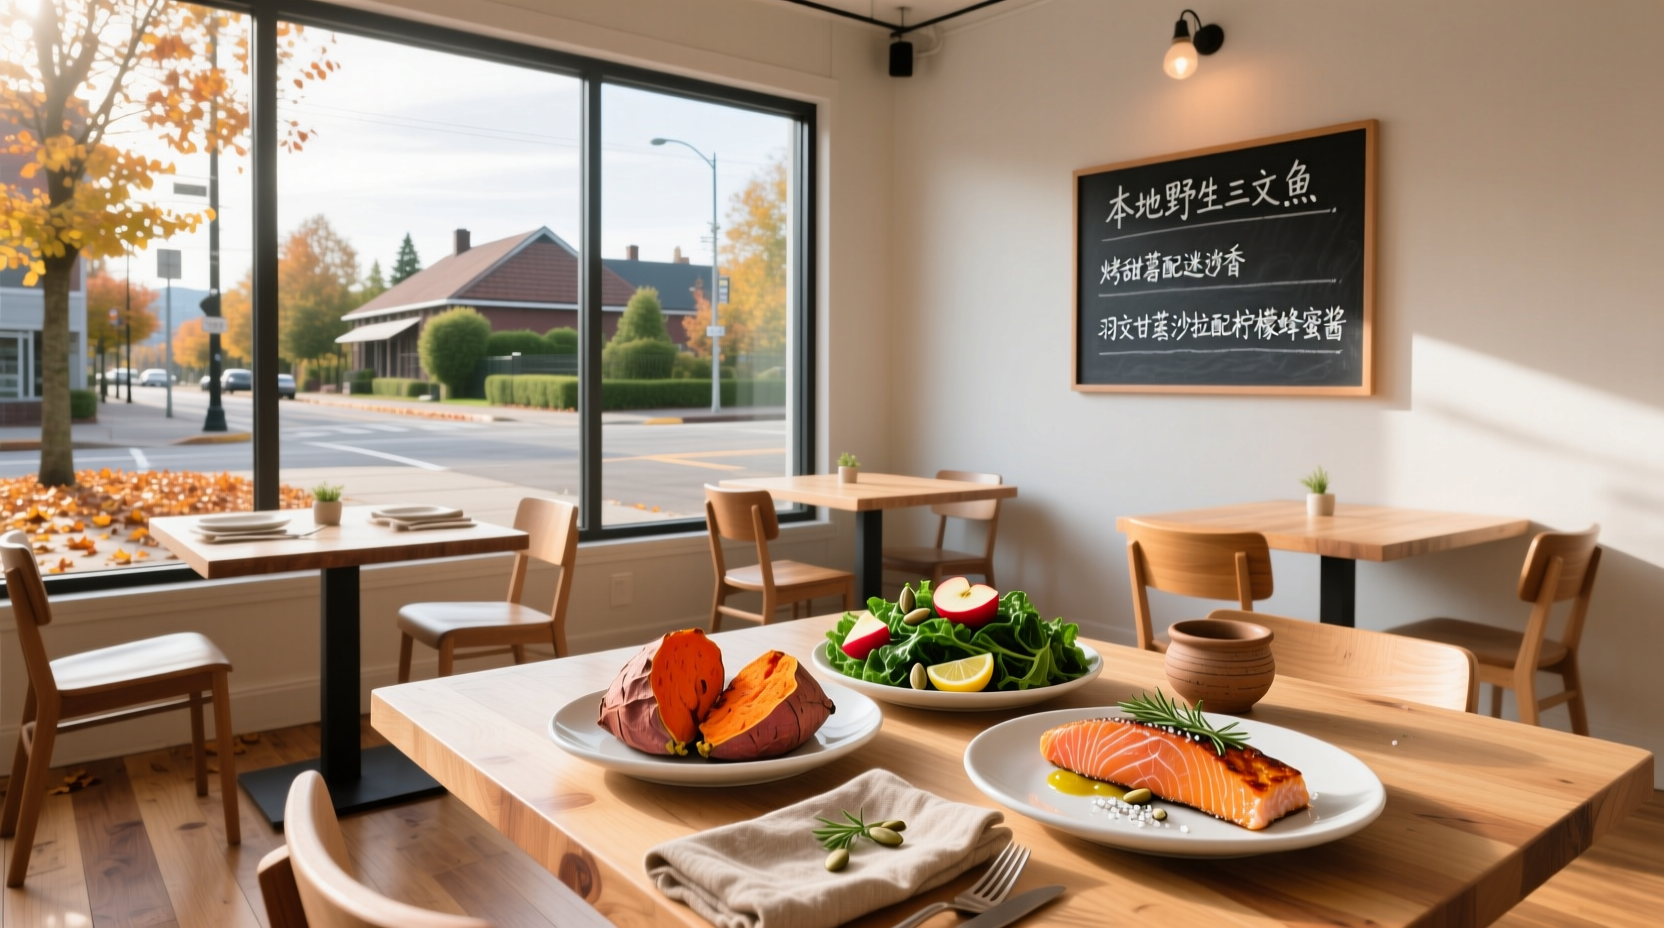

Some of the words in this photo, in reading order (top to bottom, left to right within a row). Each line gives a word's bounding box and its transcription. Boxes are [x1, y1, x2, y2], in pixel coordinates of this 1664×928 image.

[1105, 159, 1317, 230] 本地野生三文魚
